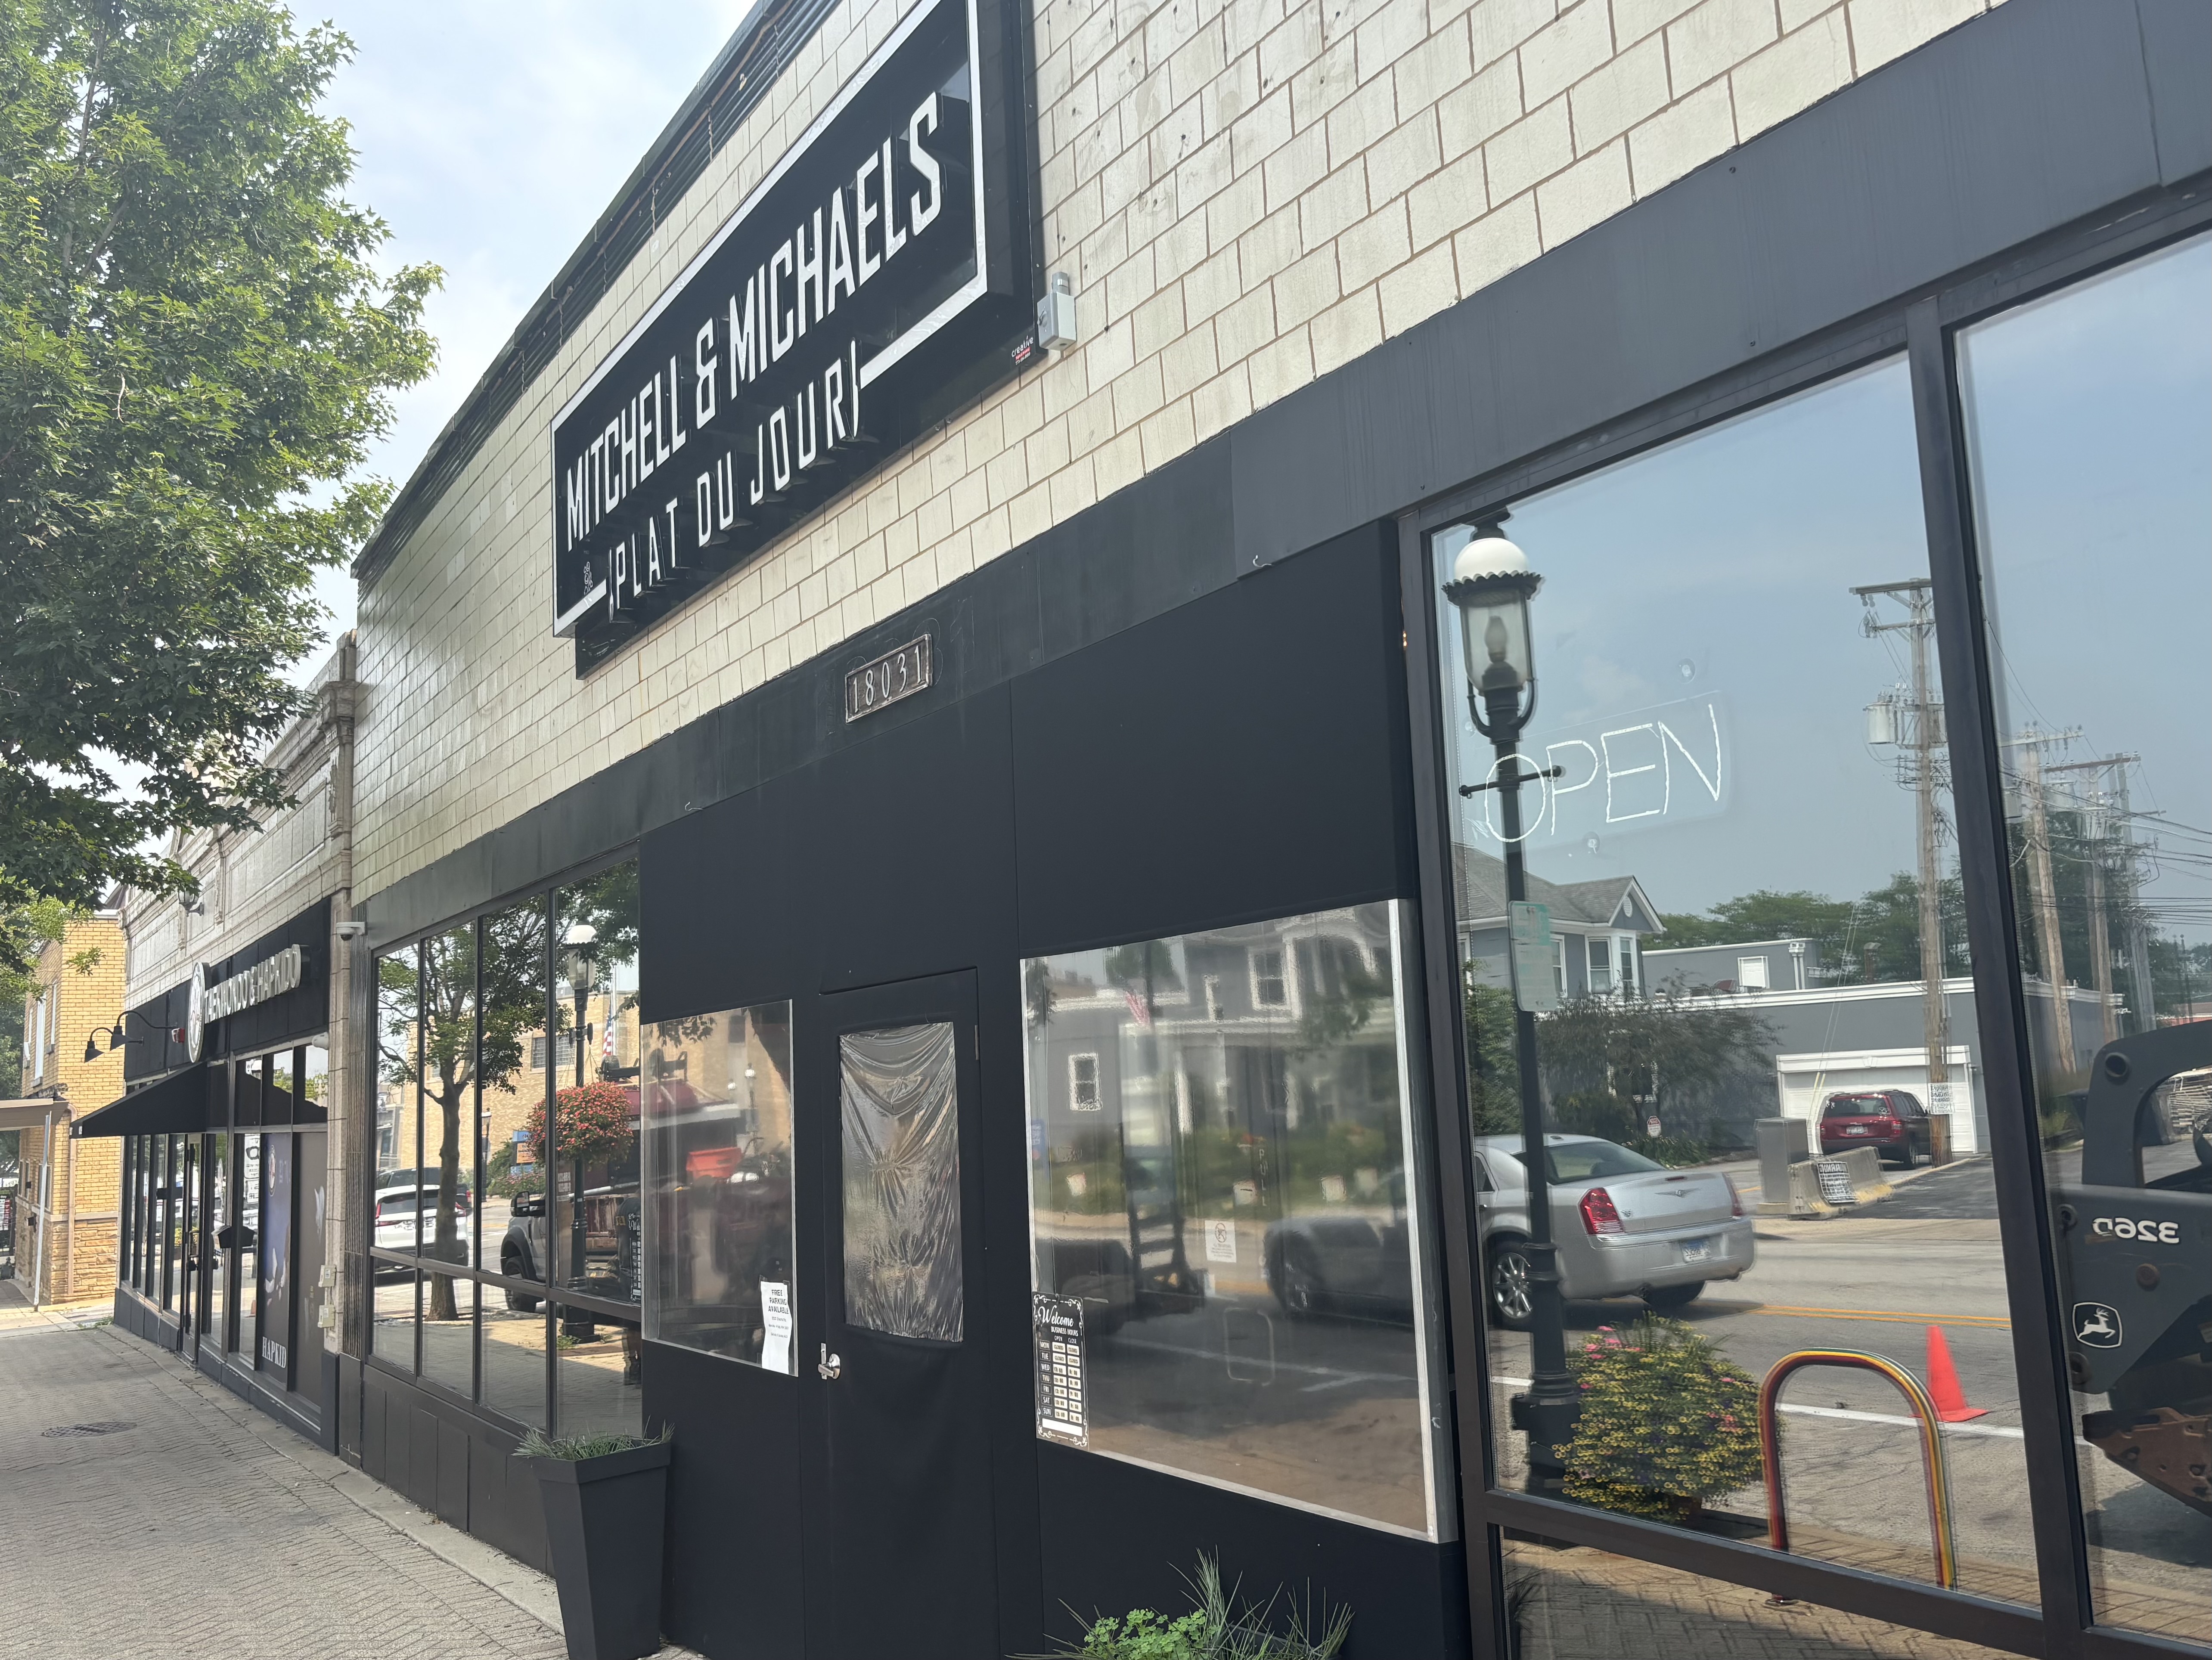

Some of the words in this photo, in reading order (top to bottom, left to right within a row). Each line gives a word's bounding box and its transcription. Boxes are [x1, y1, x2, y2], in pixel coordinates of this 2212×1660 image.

[567, 354, 687, 552] MITCHELL
[695, 317, 720, 430] &
[729, 91, 941, 400] MICHAELS
[697, 451, 734, 548] DU
[853, 645, 922, 713] 18031
[1485, 703, 1721, 842] OPEN
[257, 944, 301, 1003] HAPKIDO
[769, 1297, 787, 1305] PARKING
[768, 1305, 789, 1314] AVAILABLE
[1038, 1305, 1074, 1327] Welcome
[1051, 1326, 1067, 1335] BUSINESS
[1067, 1329, 1079, 1337] HOURS
[1040, 1340, 1050, 1349] MON
[1041, 1363, 1050, 1372] WED
[1042, 1374, 1050, 1382] THU
[1043, 1407, 1051, 1415] SUN
